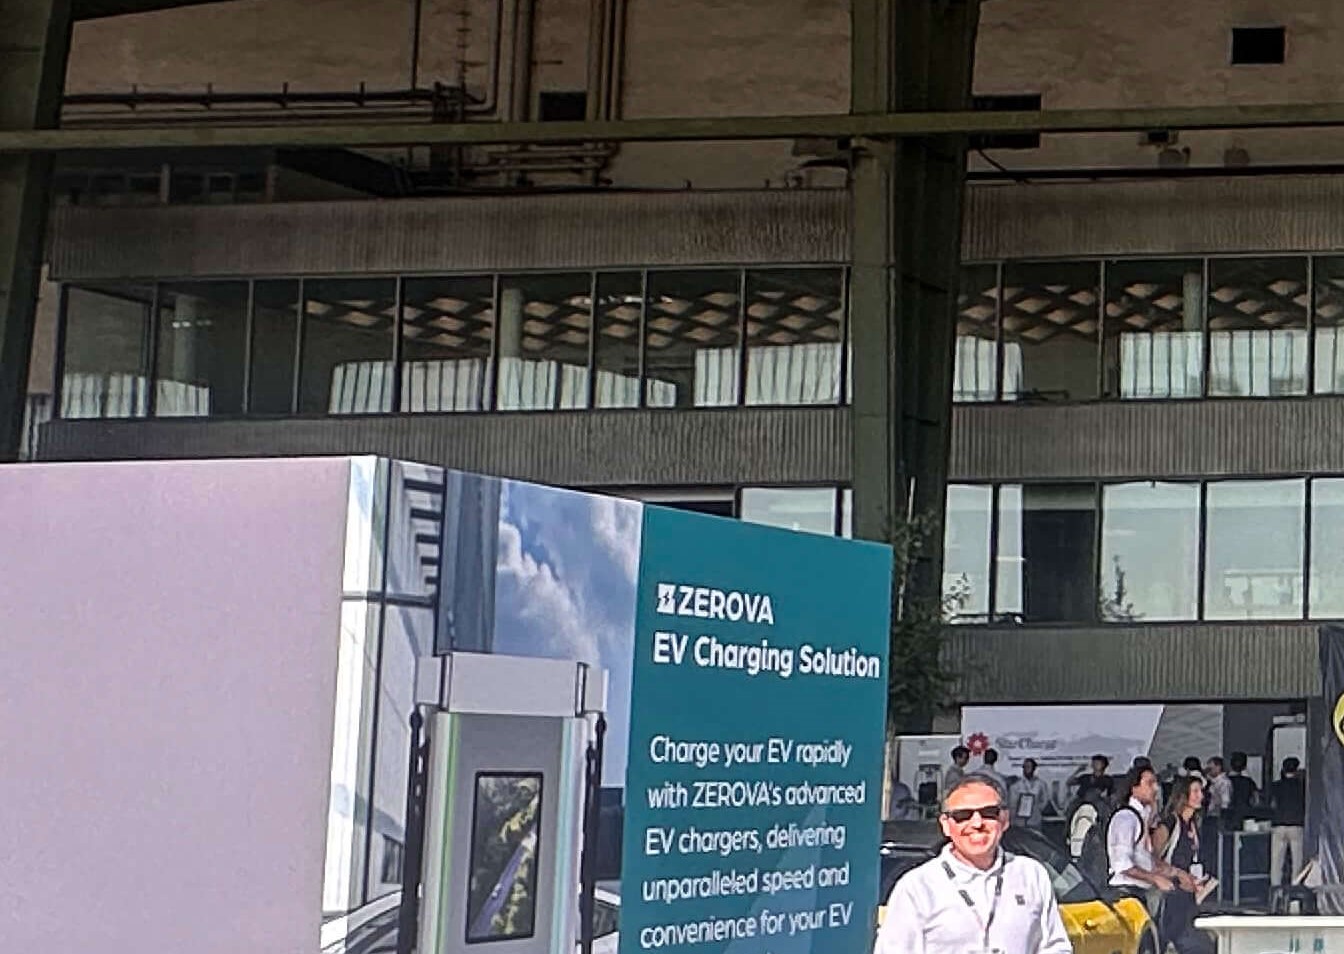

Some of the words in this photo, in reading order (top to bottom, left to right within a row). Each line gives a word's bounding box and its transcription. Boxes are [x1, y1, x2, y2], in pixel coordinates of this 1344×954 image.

[677, 586, 775, 625] ZEROVA
[653, 632, 689, 666] EV
[693, 636, 794, 678] Charging
[799, 644, 881, 680] Solution
[650, 735, 720, 766] Charge
[723, 741, 764, 769] your
[767, 738, 793, 763] EV
[796, 739, 852, 768] rapidly
[648, 781, 688, 808] with
[692, 781, 782, 808] ZEROVA's
[784, 780, 865, 804] advanced
[645, 828, 675, 855] EV
[678, 826, 763, 857] chargers,
[766, 824, 846, 852] delivering
[643, 868, 758, 904] unparalleled
[762, 864, 815, 896] speed
[818, 862, 850, 887] and
[640, 914, 757, 949] convenience
[760, 908, 786, 934] for
[788, 909, 826, 934] your
[828, 902, 854, 928] EV
